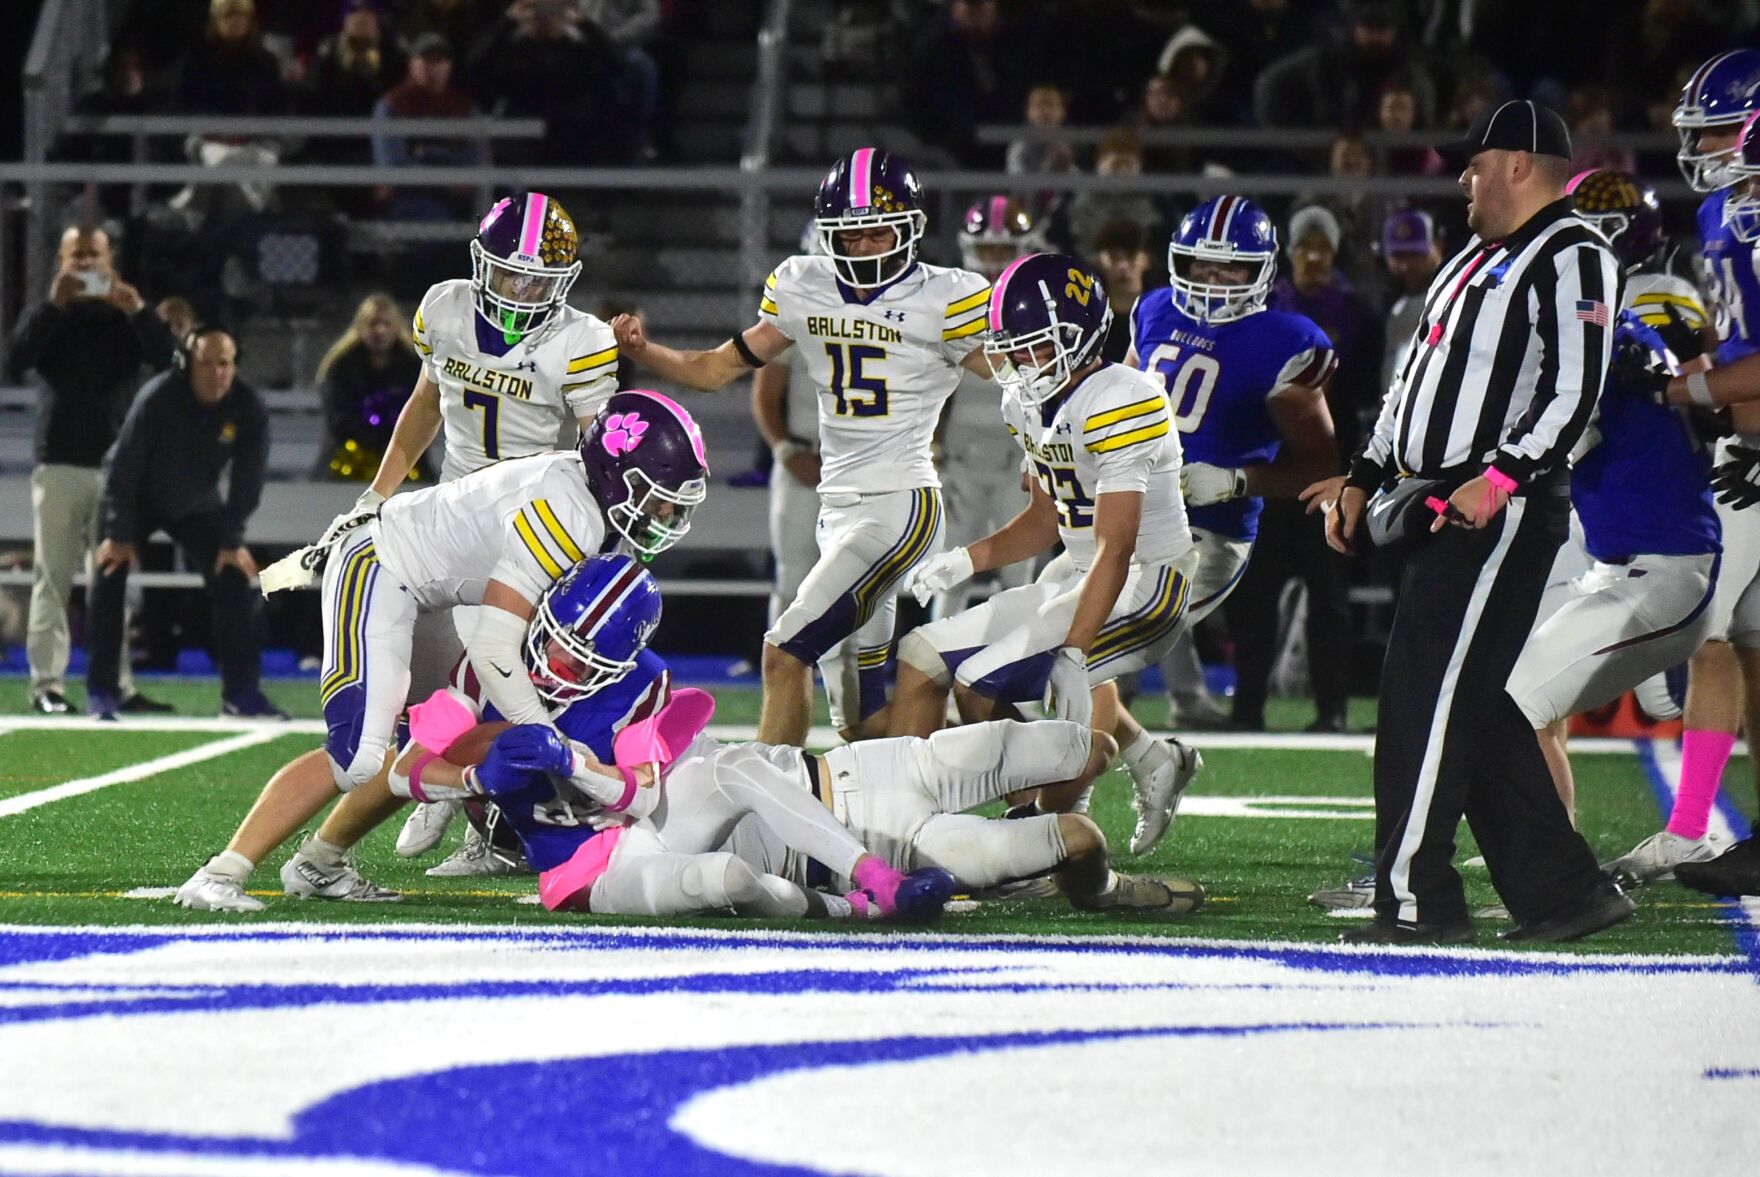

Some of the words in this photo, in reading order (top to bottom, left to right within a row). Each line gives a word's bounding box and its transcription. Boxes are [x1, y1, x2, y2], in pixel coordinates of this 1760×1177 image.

[1065, 268, 1092, 307] 22
[806, 316, 903, 343] BALLSTON
[443, 357, 533, 400] BALLSTON
[824, 342, 889, 417] 15
[462, 387, 501, 460] 7
